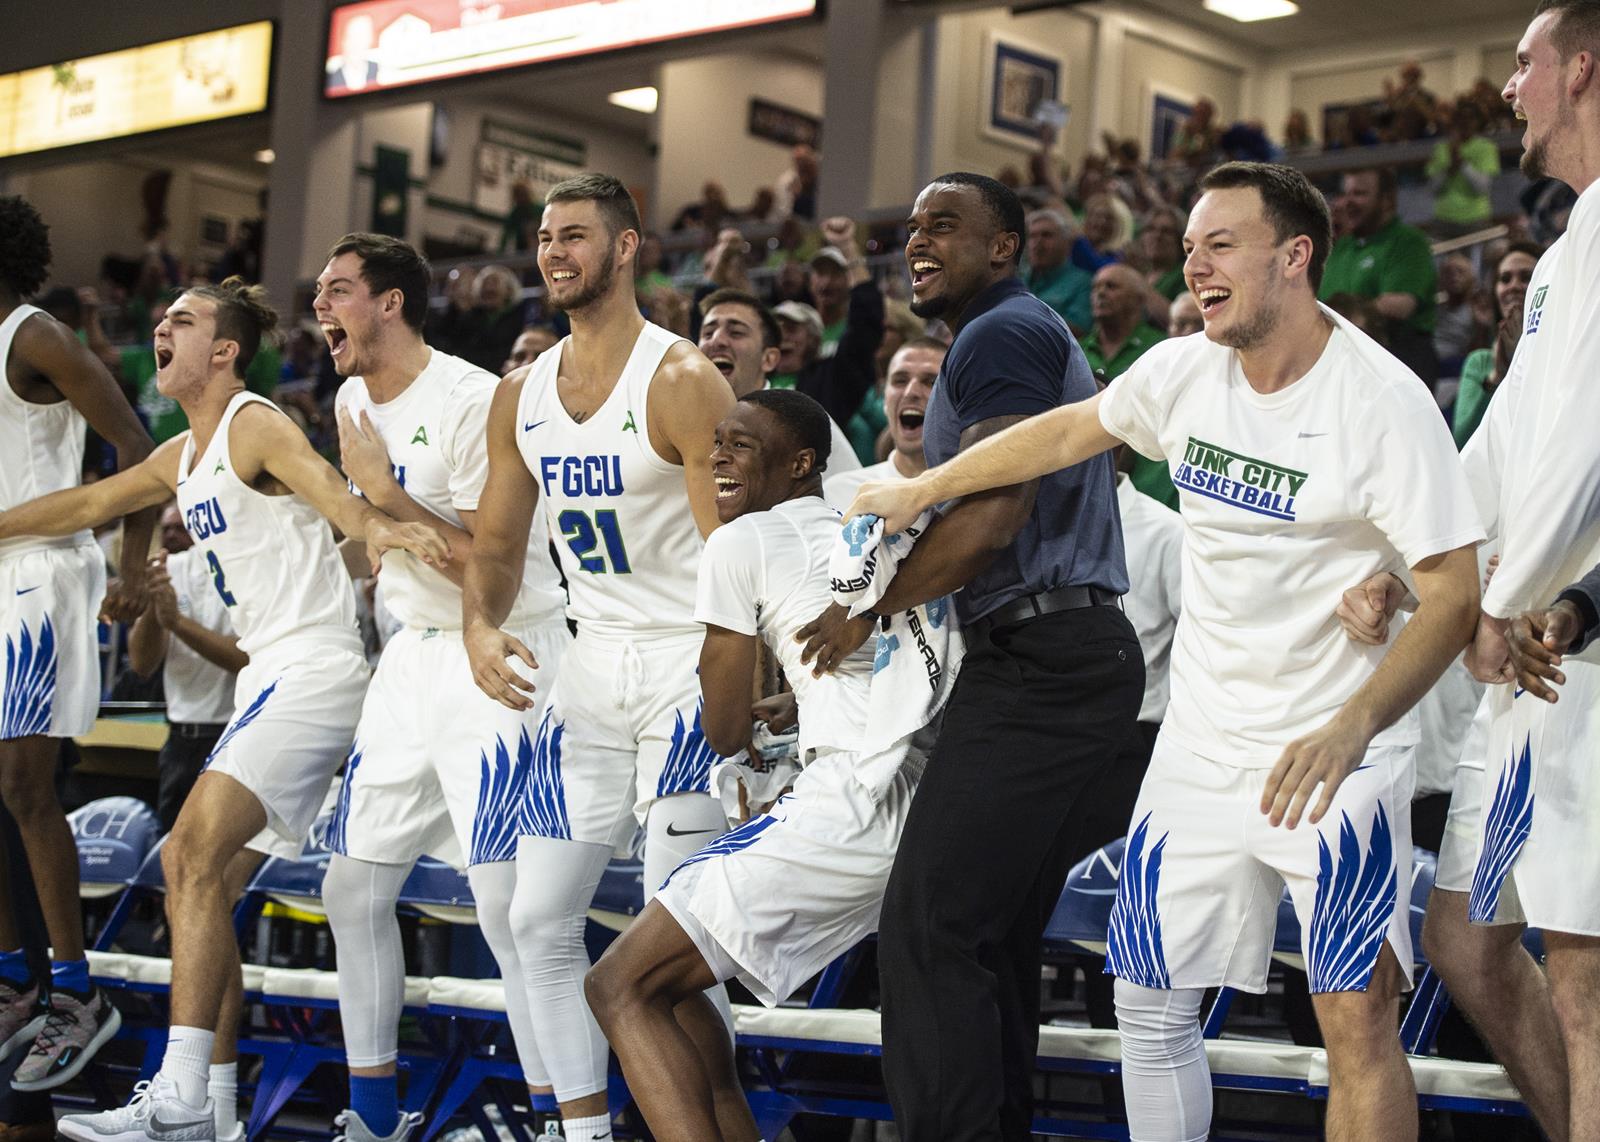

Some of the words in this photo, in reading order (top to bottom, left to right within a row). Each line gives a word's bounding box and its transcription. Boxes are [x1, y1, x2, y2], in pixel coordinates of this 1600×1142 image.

[540, 455, 625, 498] FGCU
[1174, 462, 1296, 516] BASKETBALL
[1242, 462, 1308, 498] CITY
[557, 508, 633, 575] 21
[205, 549, 238, 608] 2
